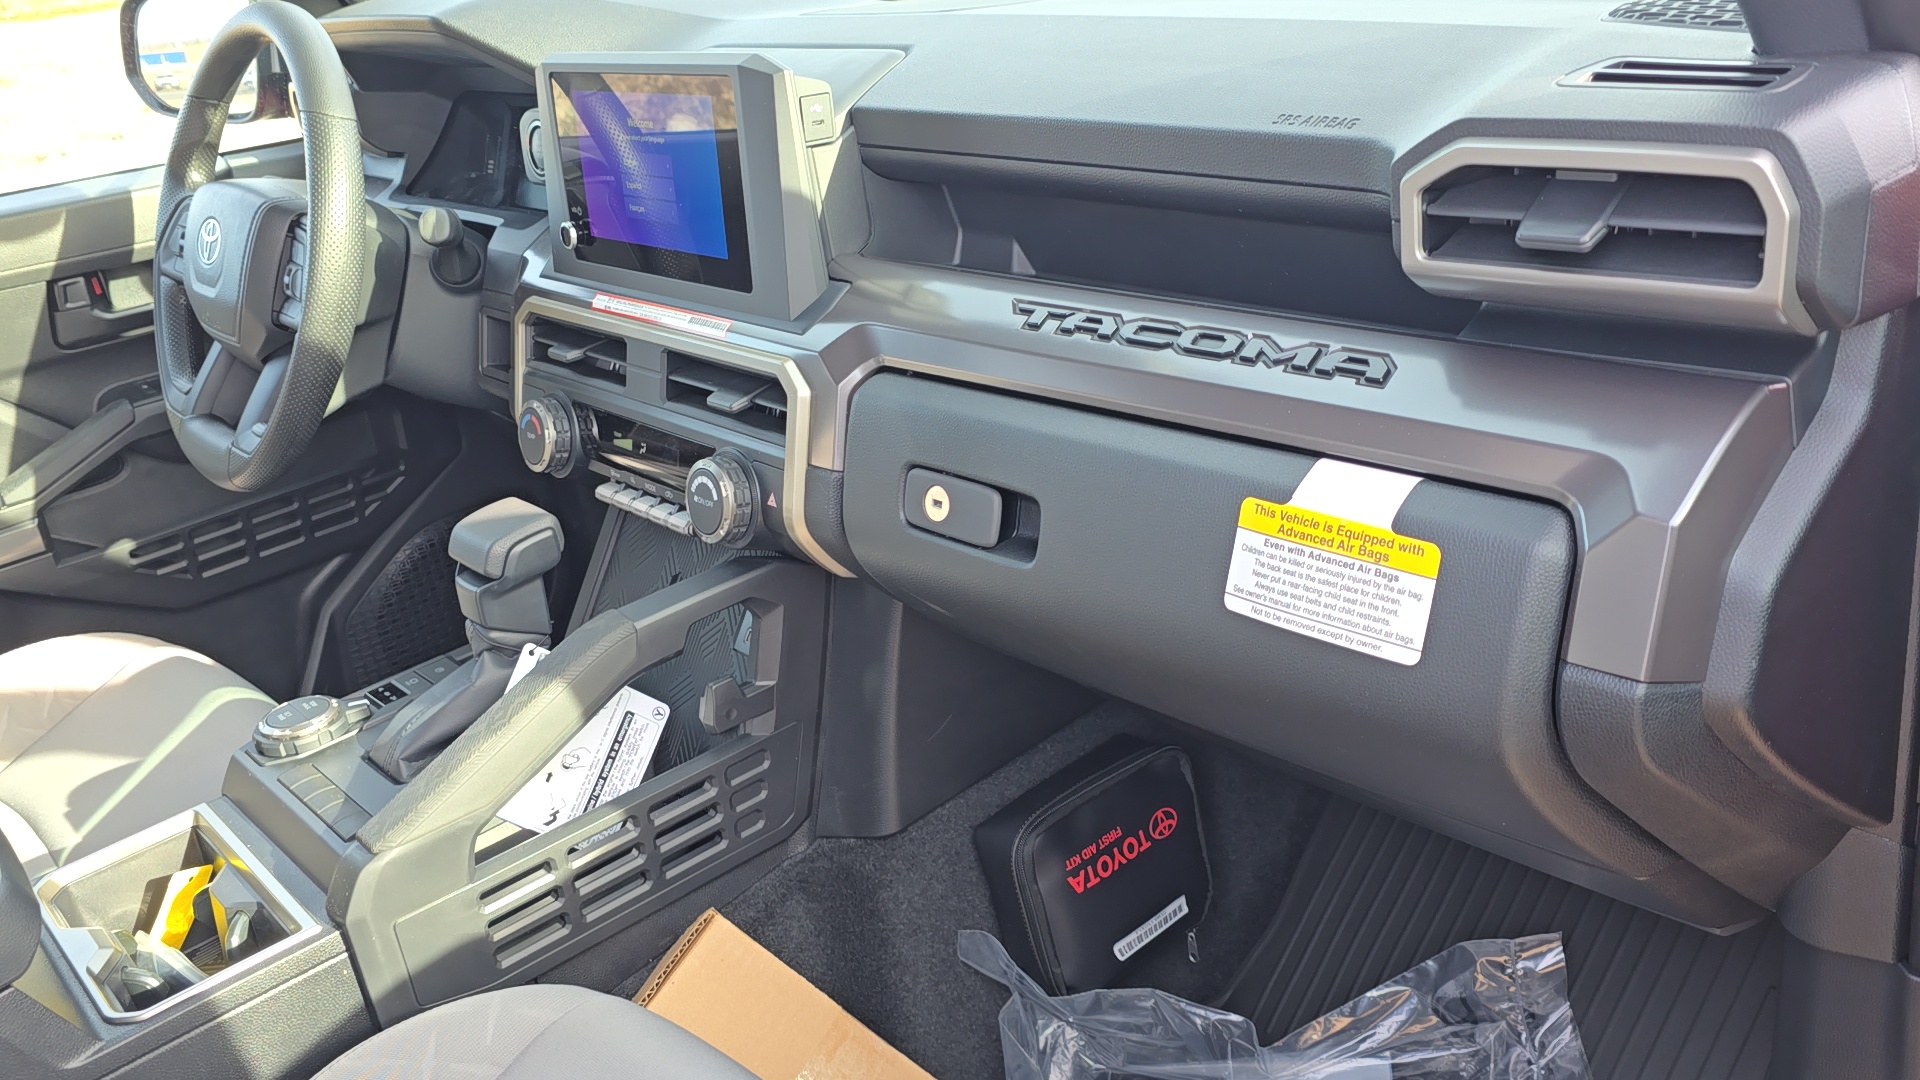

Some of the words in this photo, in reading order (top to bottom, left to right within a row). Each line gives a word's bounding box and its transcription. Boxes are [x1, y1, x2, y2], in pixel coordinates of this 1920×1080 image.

[1298, 115, 1361, 129] AIRBAG
[1014, 300, 1395, 387] TACOMA
[698, 497, 714, 508] ON/OFF
[1255, 503, 1276, 519] This
[1280, 510, 1320, 530] Vehicle
[1322, 521, 1333, 534] is
[1336, 524, 1395, 549] Equipped
[1398, 542, 1424, 557] with
[1277, 524, 1335, 548] Advanced
[1336, 539, 1355, 553] Air
[1358, 544, 1389, 564] Bags
[1241, 543, 1265, 557] Children
[1266, 552, 1278, 561] can
[1278, 554, 1287, 563] be
[1288, 557, 1305, 569] killed
[1315, 566, 1346, 581] seriously
[1347, 573, 1372, 587] injured
[1373, 580, 1382, 591] by
[1383, 583, 1395, 593] the
[1396, 587, 1407, 596] air
[1408, 589, 1423, 602] bag.
[1255, 558, 1266, 568] The
[1266, 562, 1281, 573] back
[1282, 568, 1297, 577] seat
[1297, 571, 1304, 579] is
[1305, 574, 1316, 583] the
[1317, 578, 1339, 589] safest
[1339, 584, 1359, 595] place
[1360, 588, 1370, 597] for
[1371, 592, 1402, 607] children.
[1264, 538, 1285, 552] Even
[1287, 546, 1306, 557] with
[1307, 551, 1355, 570] Advanced
[1357, 564, 1372, 575] Air
[1374, 567, 1399, 583] Bags
[1233, 584, 1244, 594] See
[1245, 589, 1267, 602] owner's
[1268, 597, 1292, 609] manual
[1292, 603, 1302, 612] for
[1302, 607, 1320, 618] more
[1321, 611, 1360, 629] information
[1362, 624, 1383, 636] about
[1384, 630, 1394, 639] air
[1395, 632, 1415, 645] bags.
[1252, 568, 1270, 580] Never
[1270, 576, 1281, 584] put
[1287, 581, 1323, 598] rear-facing
[1324, 591, 1342, 601] child
[1342, 596, 1358, 606] seat
[1359, 599, 1366, 608] in
[1367, 602, 1379, 612] the
[1381, 605, 1399, 617] front.
[1254, 580, 1275, 594] Always
[1277, 589, 1288, 597] use
[1290, 592, 1304, 602] seat
[1305, 595, 1322, 607] belts
[1323, 602, 1337, 611] and
[1338, 606, 1355, 616] child
[1356, 611, 1391, 627] restraints.
[1251, 605, 1263, 616] Not
[1264, 610, 1271, 618] to
[1272, 612, 1282, 622] be
[1283, 617, 1316, 632] removed
[1317, 628, 1343, 640] except
[1345, 634, 1355, 645] by
[1356, 639, 1382, 652] owner.
[1080, 844, 1097, 860] AID
[1098, 827, 1122, 849] FIRST
[1066, 830, 1151, 894] TOYOTA
[1066, 854, 1082, 871] KIT
